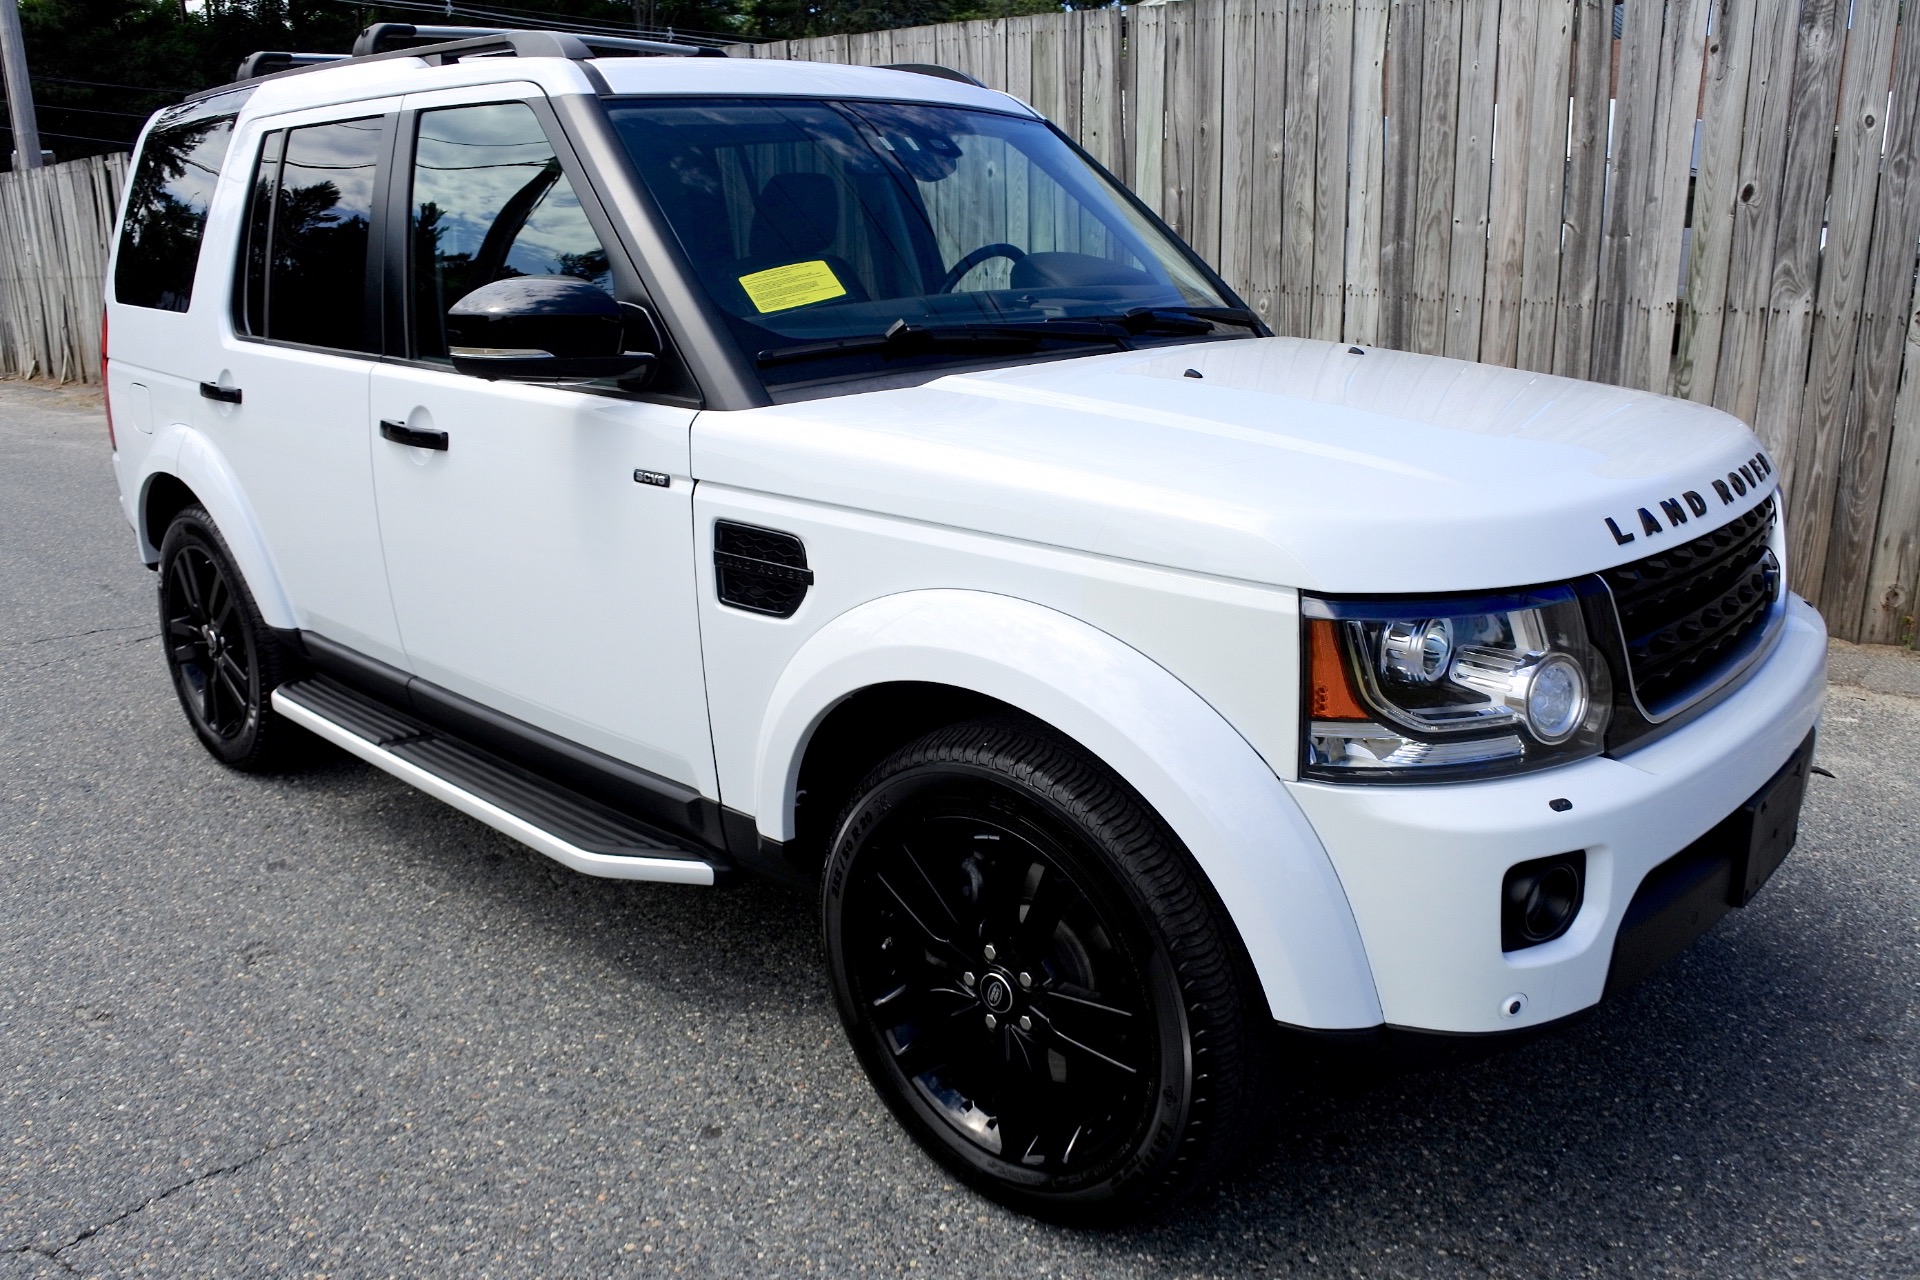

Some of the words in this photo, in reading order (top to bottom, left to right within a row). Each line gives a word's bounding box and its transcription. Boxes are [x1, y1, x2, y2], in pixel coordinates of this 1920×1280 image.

[635, 471, 666, 485] SCV6
[1604, 491, 1707, 545] LAND
[1712, 452, 1772, 505] ROVER
[757, 564, 805, 581] ROVER
